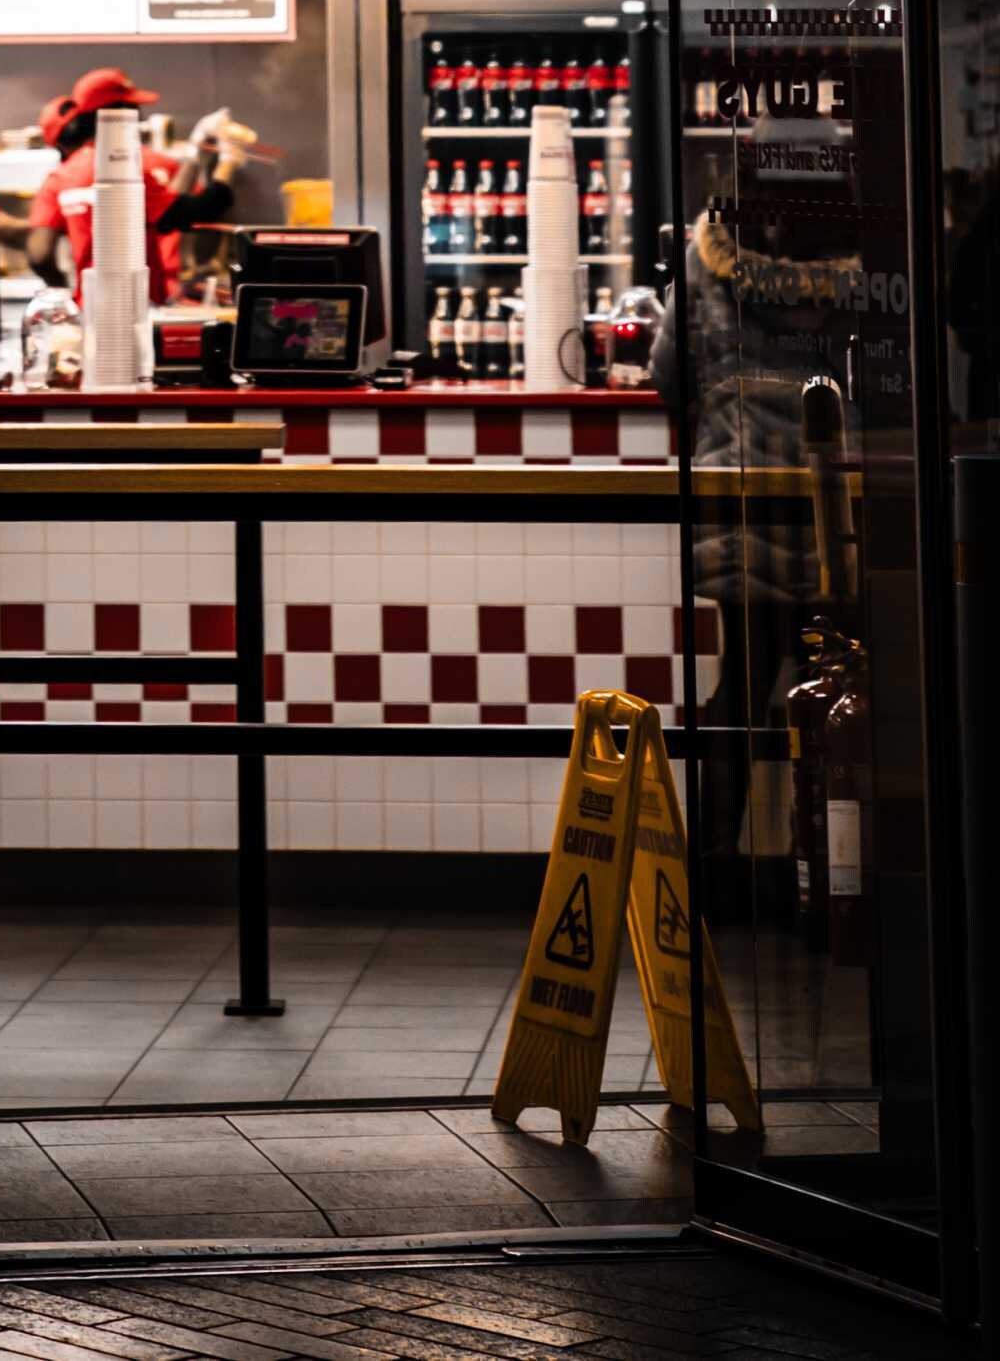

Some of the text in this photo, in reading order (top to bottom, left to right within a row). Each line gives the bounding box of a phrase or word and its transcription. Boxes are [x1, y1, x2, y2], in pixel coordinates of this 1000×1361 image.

[562, 824, 617, 863] CAUTION
[530, 974, 596, 1019] WET FLOOR
